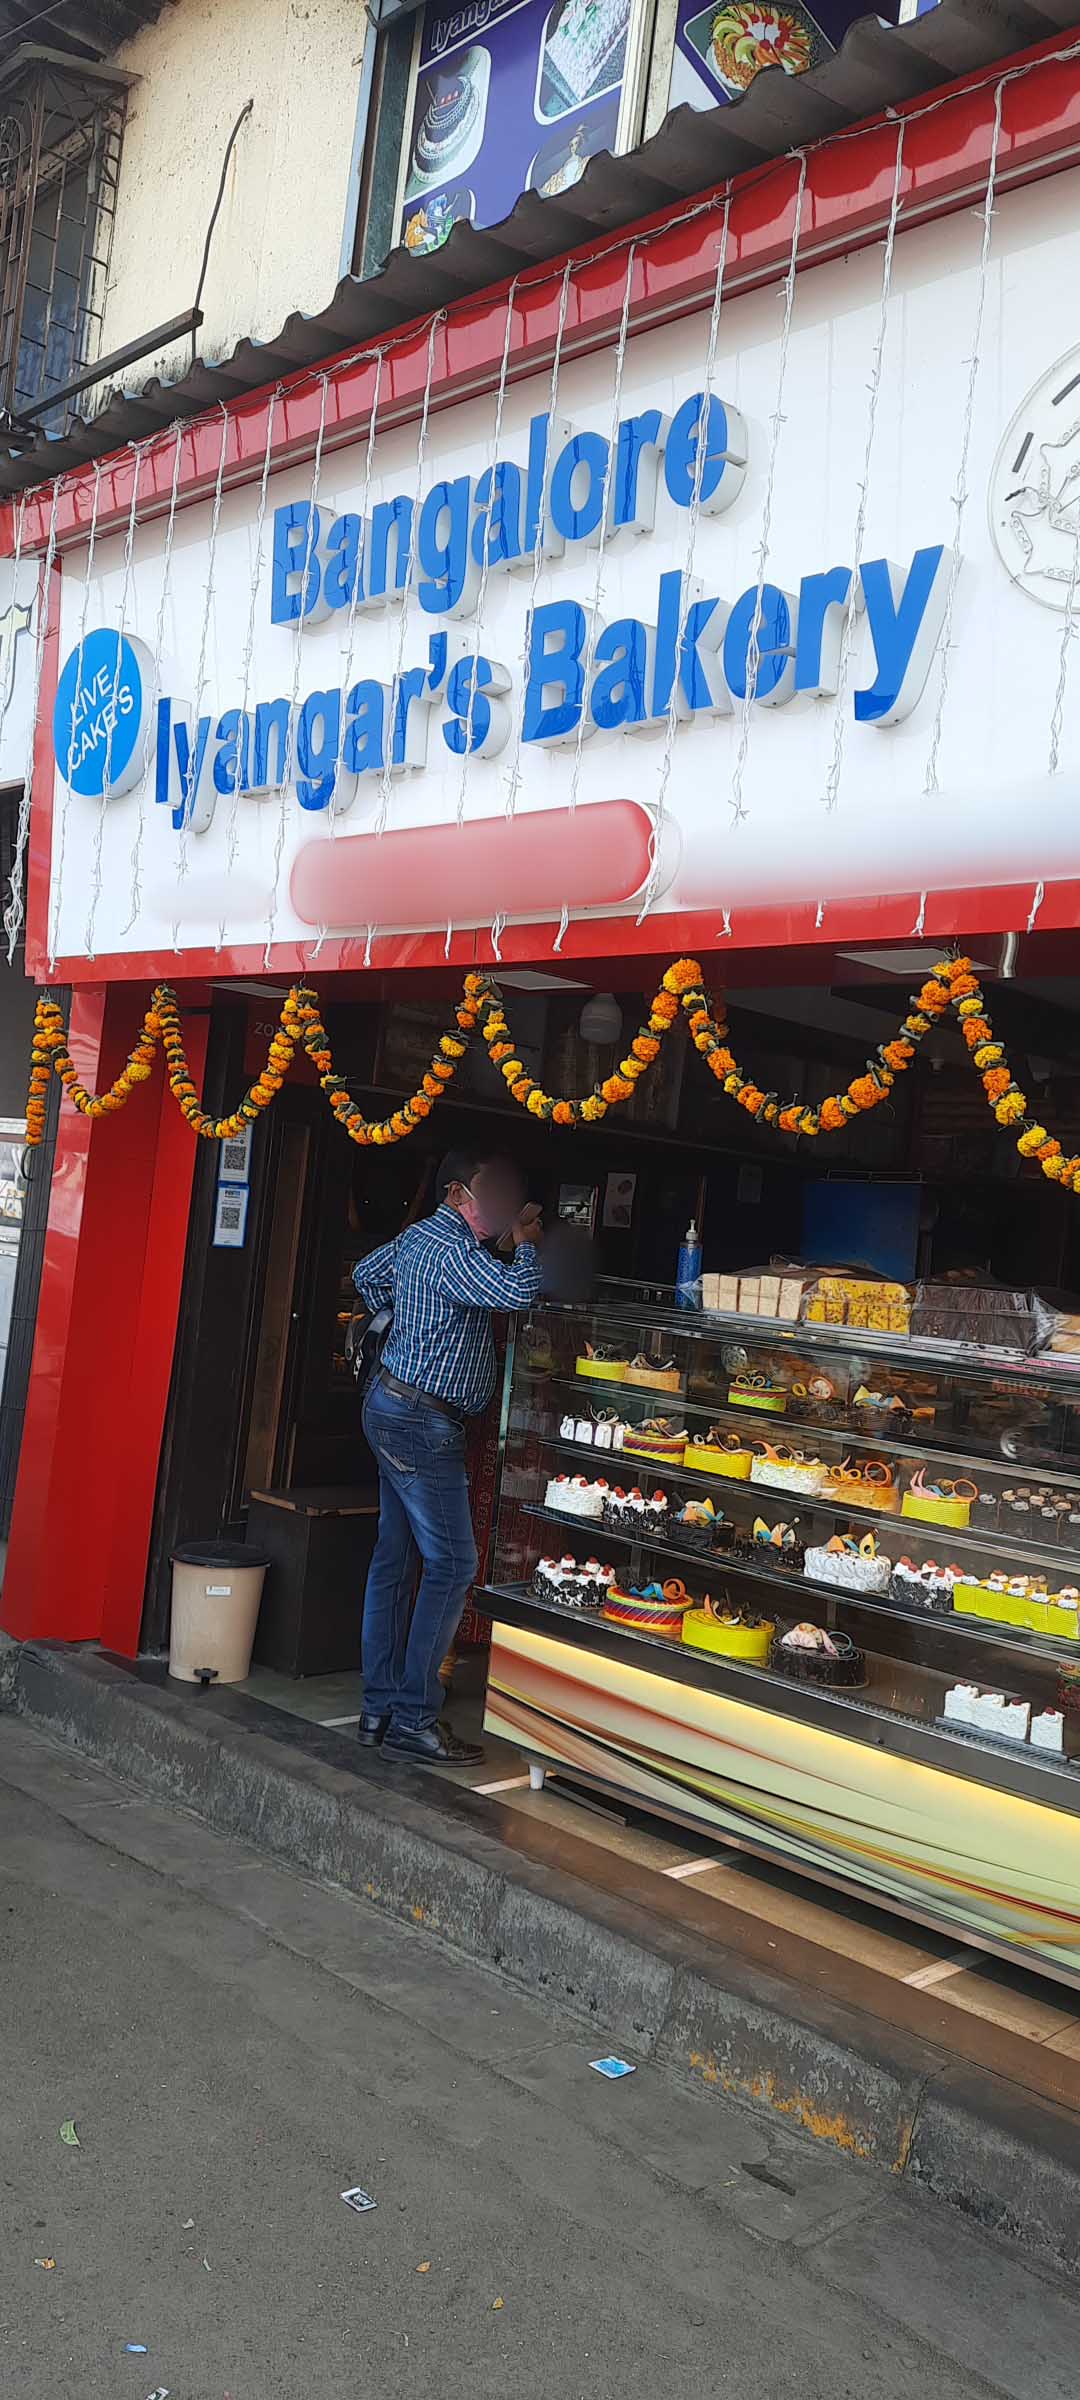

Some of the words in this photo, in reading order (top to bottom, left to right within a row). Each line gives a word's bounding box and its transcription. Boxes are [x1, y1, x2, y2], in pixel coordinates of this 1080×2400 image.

[271, 392, 729, 624] Bangalore
[71, 665, 112, 726] LIVE
[156, 631, 491, 830] Iyangar's
[521, 544, 945, 742] Bakery
